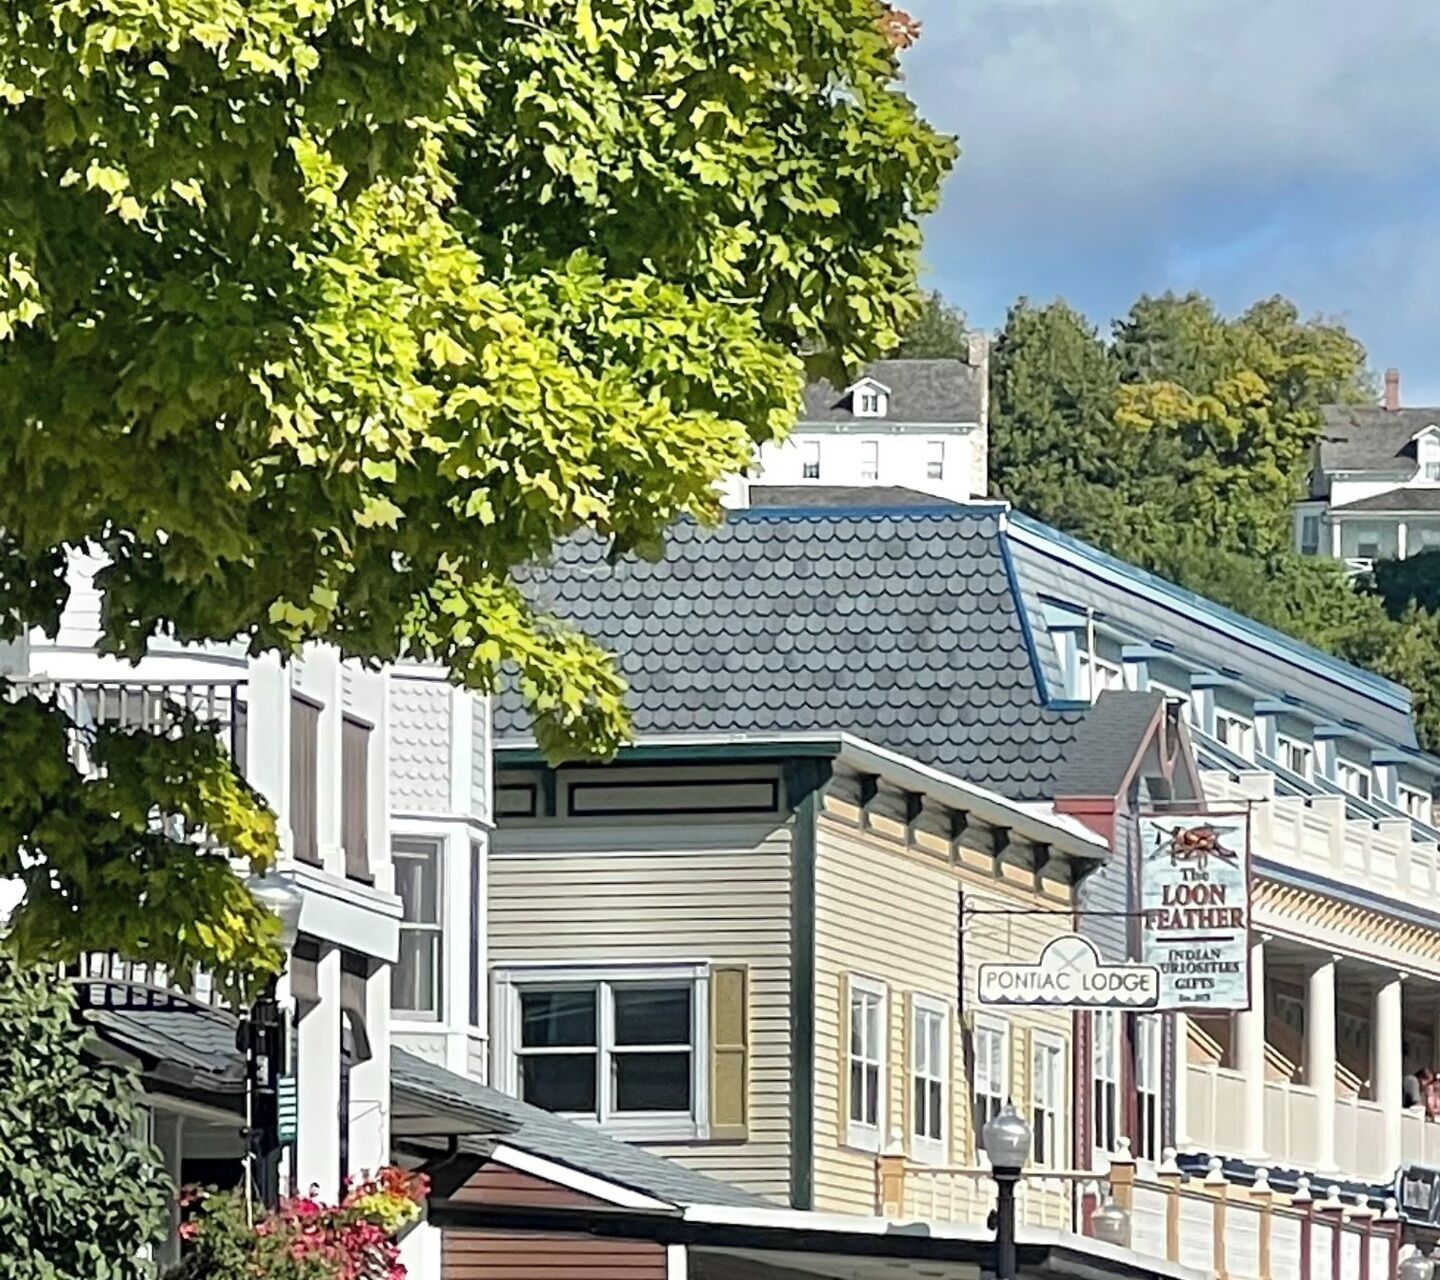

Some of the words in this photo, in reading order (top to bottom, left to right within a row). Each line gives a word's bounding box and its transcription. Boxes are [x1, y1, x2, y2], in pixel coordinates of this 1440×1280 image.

[1180, 868, 1209, 882] The
[1162, 885, 1226, 906] LOON
[1143, 907, 1245, 930] FEATHER
[1169, 949, 1221, 961] INDIAN
[1160, 962, 1239, 974] URIOSITIES
[986, 971, 1070, 991] PONTIAC
[1083, 972, 1150, 992] LODGE
[1175, 977, 1215, 990] GIFTS
